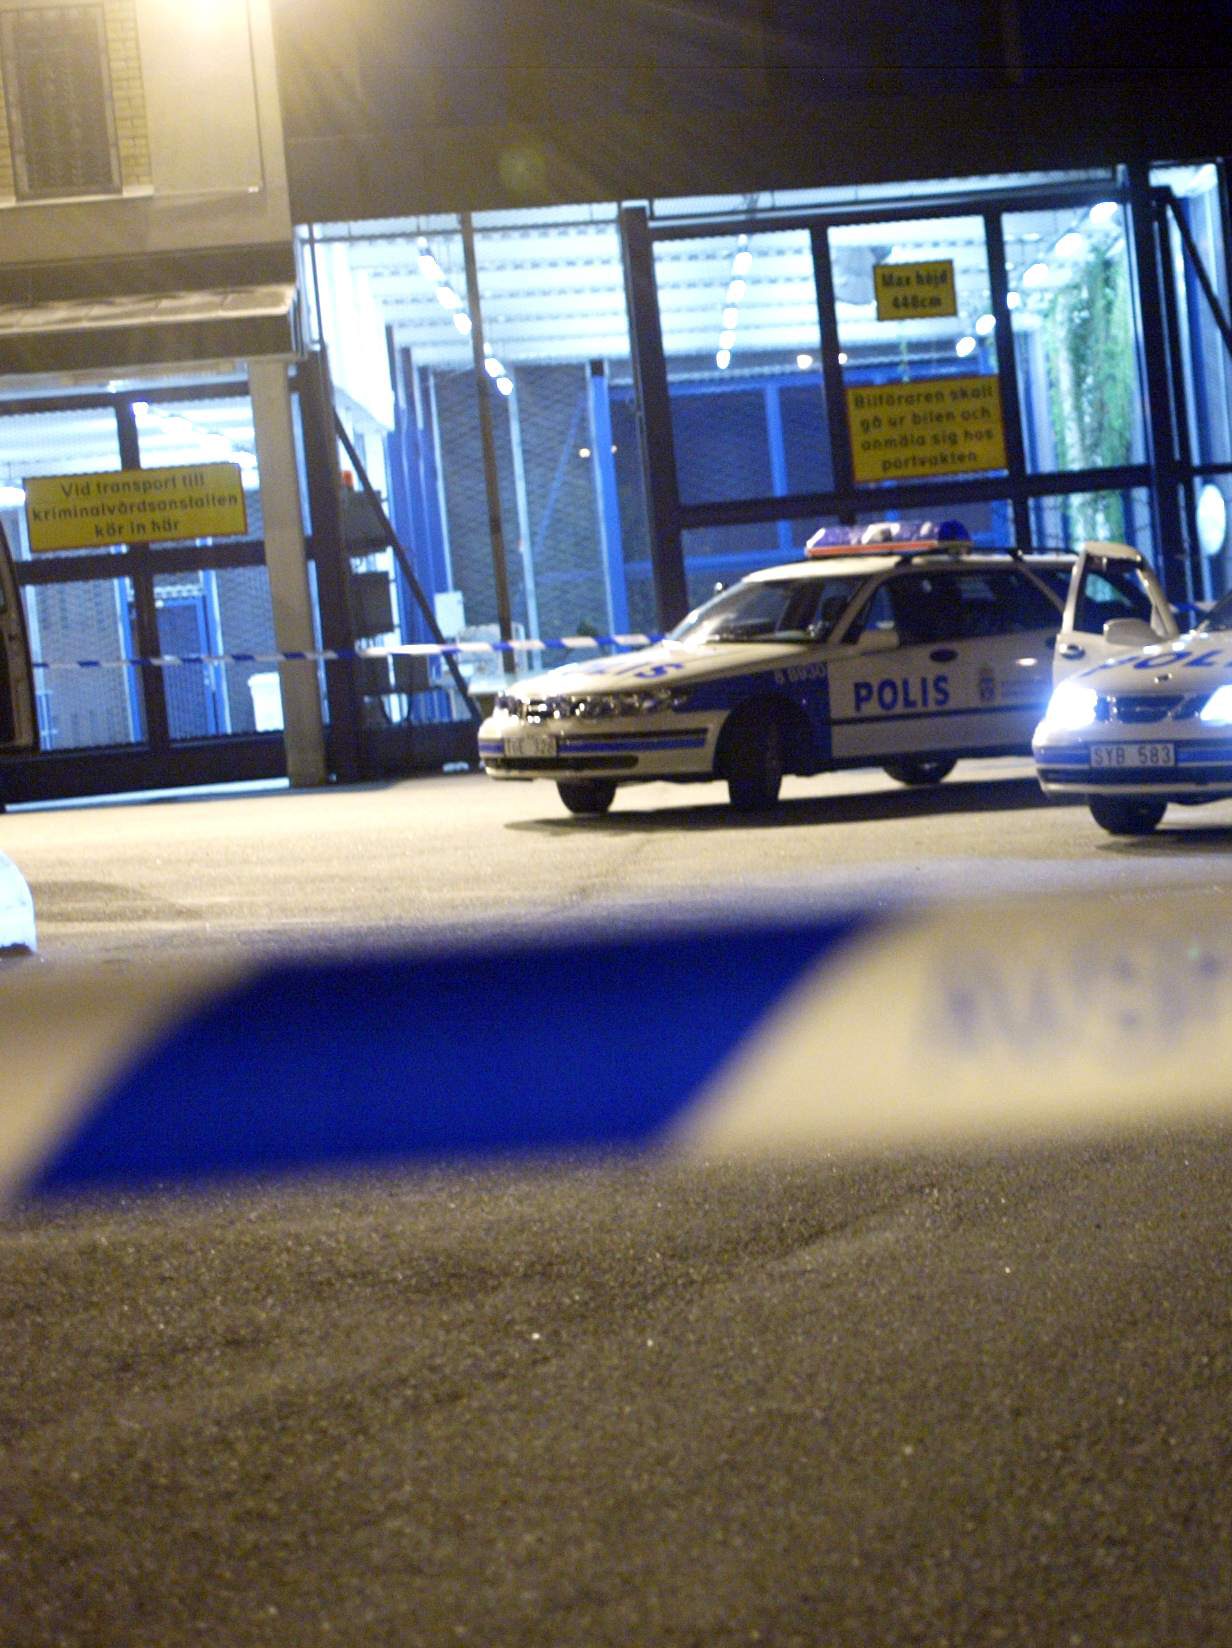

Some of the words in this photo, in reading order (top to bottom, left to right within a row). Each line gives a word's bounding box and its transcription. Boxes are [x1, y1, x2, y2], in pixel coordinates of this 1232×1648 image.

[949, 384, 994, 402] skall
[860, 414, 882, 434] gå
[887, 415, 906, 428] ur
[911, 410, 956, 426] bilen
[960, 405, 992, 422] och
[861, 432, 927, 451] anmäla
[930, 430, 958, 447] sig
[963, 428, 995, 442] hos
[882, 450, 978, 473] portvakten
[60, 479, 91, 498] Vid
[96, 474, 177, 496] transport
[182, 471, 206, 488] till
[32, 493, 238, 522] kriminalvårdsanstalten
[94, 521, 124, 538] kör
[129, 519, 148, 535] in
[151, 517, 181, 534] här
[854, 675, 950, 712] POLIS
[1093, 746, 1126, 766] SYB
[1138, 744, 1171, 764] 583
